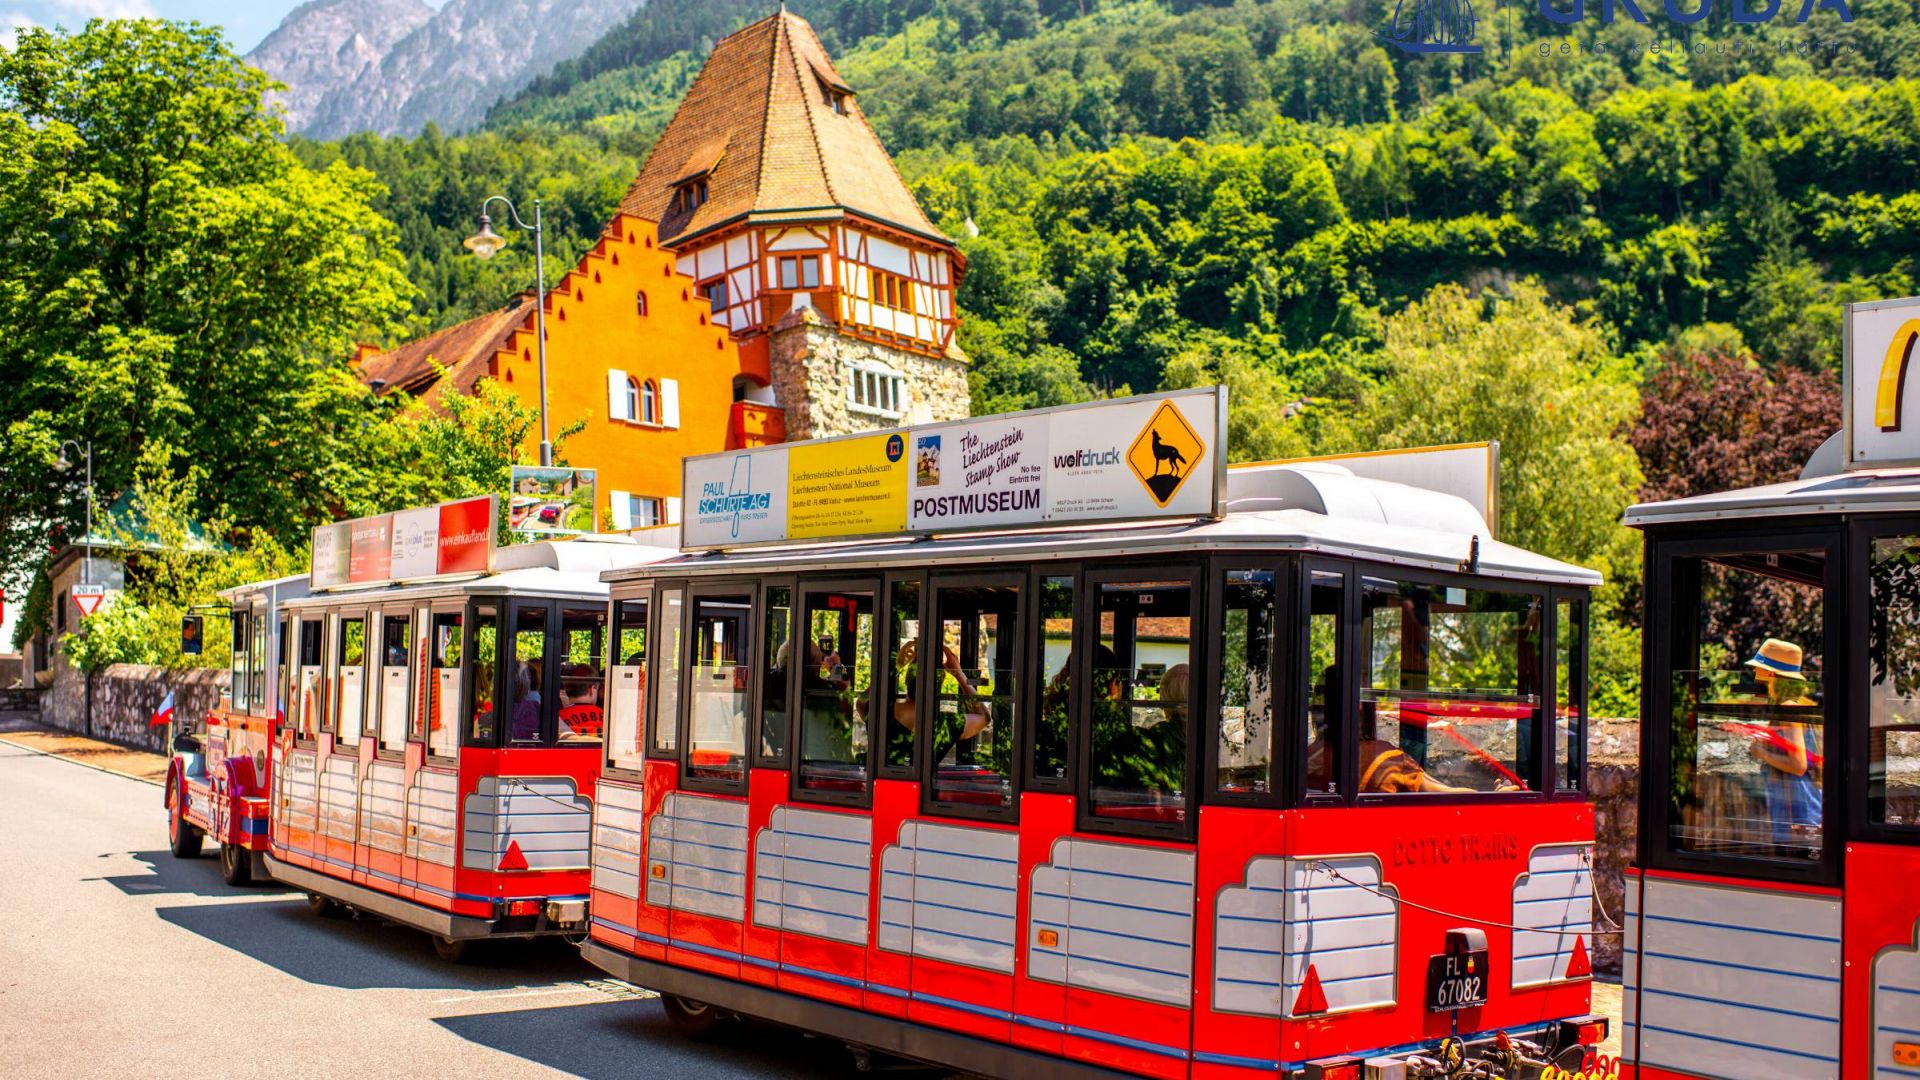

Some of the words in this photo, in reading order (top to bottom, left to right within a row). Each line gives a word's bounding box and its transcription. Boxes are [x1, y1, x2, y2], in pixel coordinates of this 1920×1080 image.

[960, 430, 979, 452] The
[962, 427, 1024, 470] Liechtenstein
[1054, 447, 1120, 469] wolfdruck
[965, 464, 996, 488] Stamp
[1009, 475, 1029, 484] Eintritt
[1030, 474, 1041, 482] frei
[1021, 466, 1030, 474] No
[1031, 465, 1041, 473] fee
[703, 481, 725, 497] PAUL
[792, 484, 829, 496] Liechtenstein
[829, 480, 853, 491] National
[854, 479, 881, 489] Museum
[750, 494, 768, 510] AG
[914, 488, 1041, 518] POSTMUSEUM
[77, 586, 88, 594] 20
[1392, 837, 1453, 868] DOTTO
[1459, 833, 1518, 864] TRAINS
[1446, 956, 1461, 977] FL
[1438, 976, 1480, 1006] 67082
